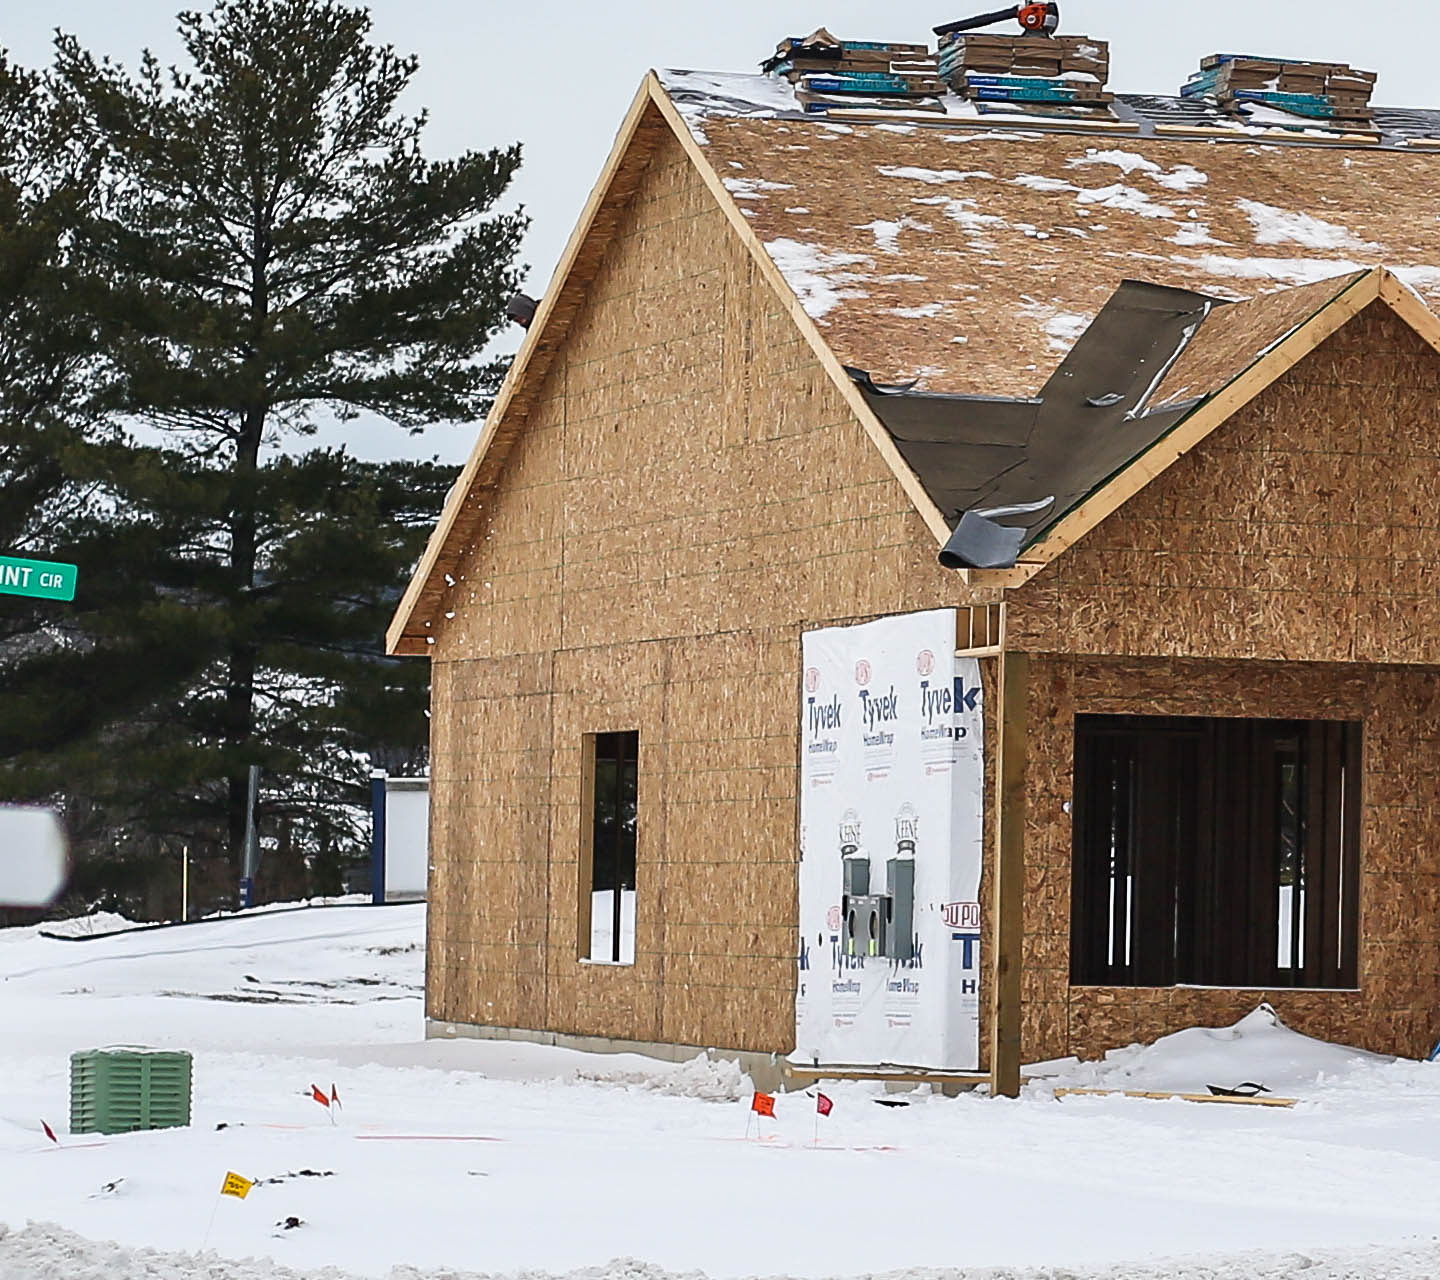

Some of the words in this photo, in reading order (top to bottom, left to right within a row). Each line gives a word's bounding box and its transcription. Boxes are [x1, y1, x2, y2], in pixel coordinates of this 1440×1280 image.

[39, 572, 63, 589] CIR
[808, 693, 843, 740] Tyvek
[858, 685, 899, 732] Tyvek
[920, 676, 982, 726] Tyvek
